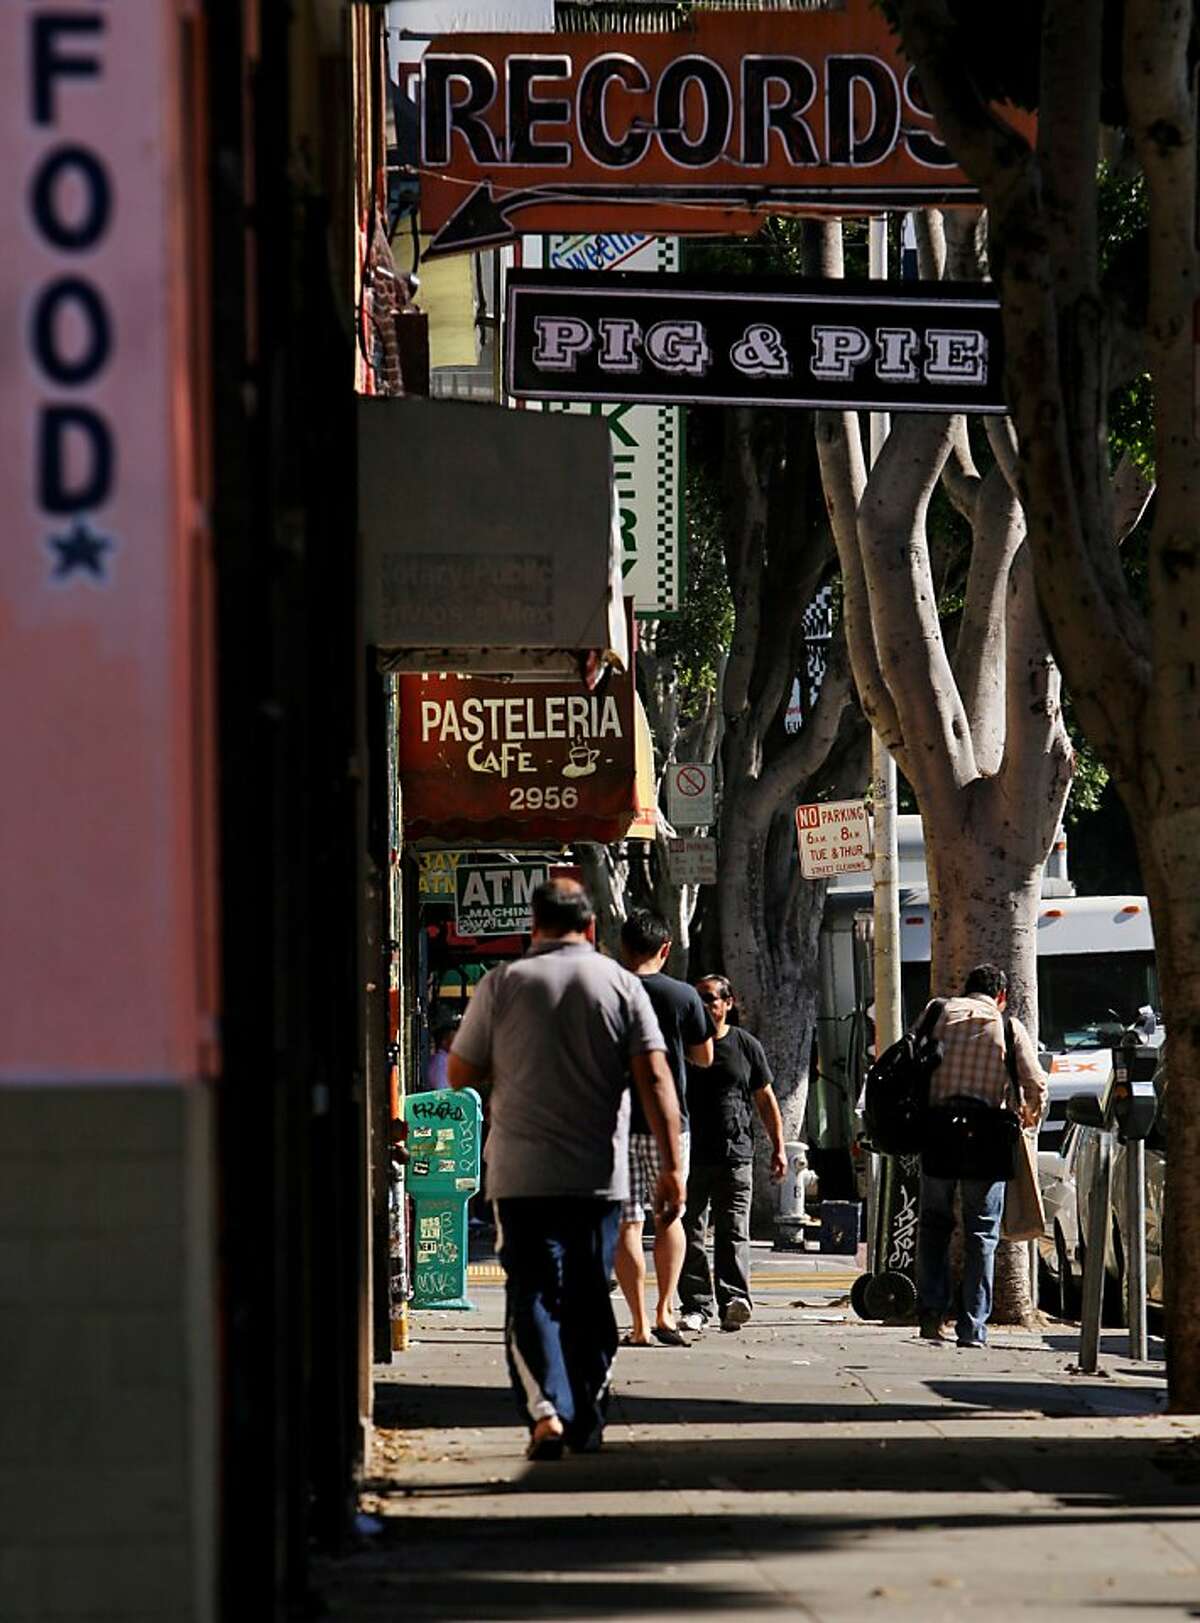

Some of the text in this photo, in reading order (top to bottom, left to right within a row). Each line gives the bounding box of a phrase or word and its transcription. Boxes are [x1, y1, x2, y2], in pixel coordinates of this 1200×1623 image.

[421, 53, 959, 169] RECORDS
[29, 15, 116, 517] FOOD
[532, 315, 989, 386] PIG & PIE
[421, 695, 623, 742] PASTELERIA
[509, 787, 579, 810] 2956
[799, 807, 864, 827] NO PARKING
[810, 845, 863, 861] TUE & THUR
[462, 870, 544, 906] ATM
[469, 907, 530, 918] MACHIN
